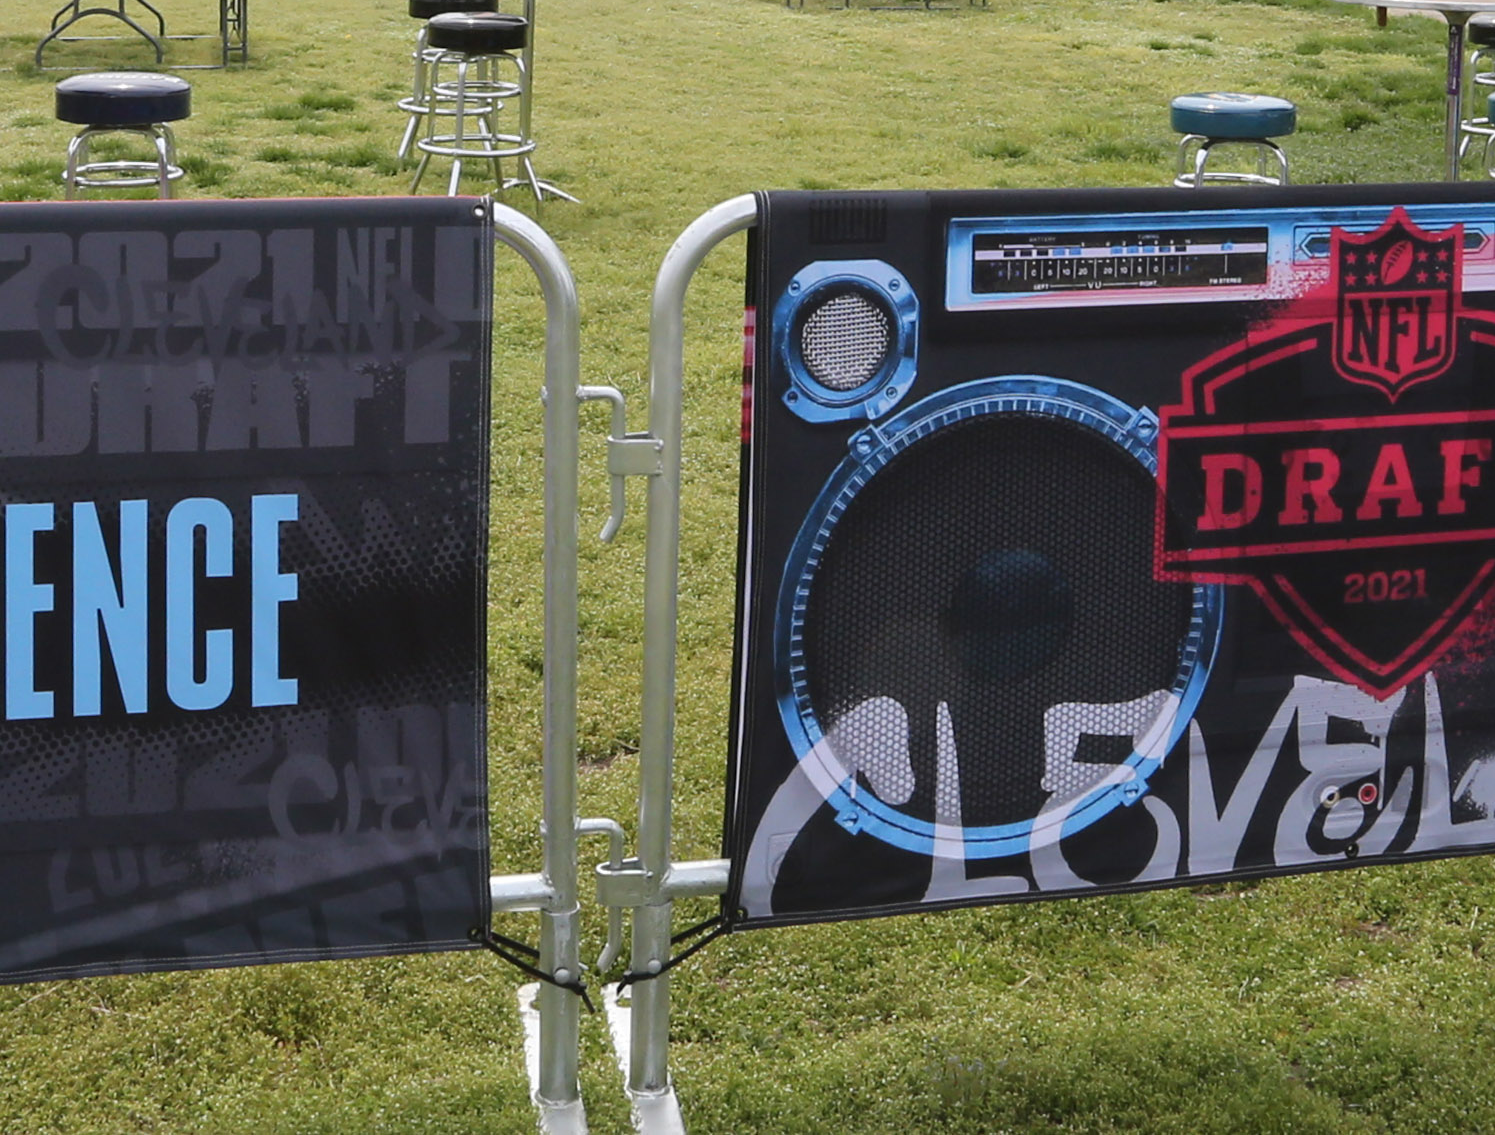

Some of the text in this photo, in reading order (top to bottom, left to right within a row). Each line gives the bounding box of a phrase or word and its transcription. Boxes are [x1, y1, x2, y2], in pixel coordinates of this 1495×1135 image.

[1087, 281, 1102, 289] VU
[1343, 305, 1440, 372] NFL
[1343, 568, 1429, 605] 2021
